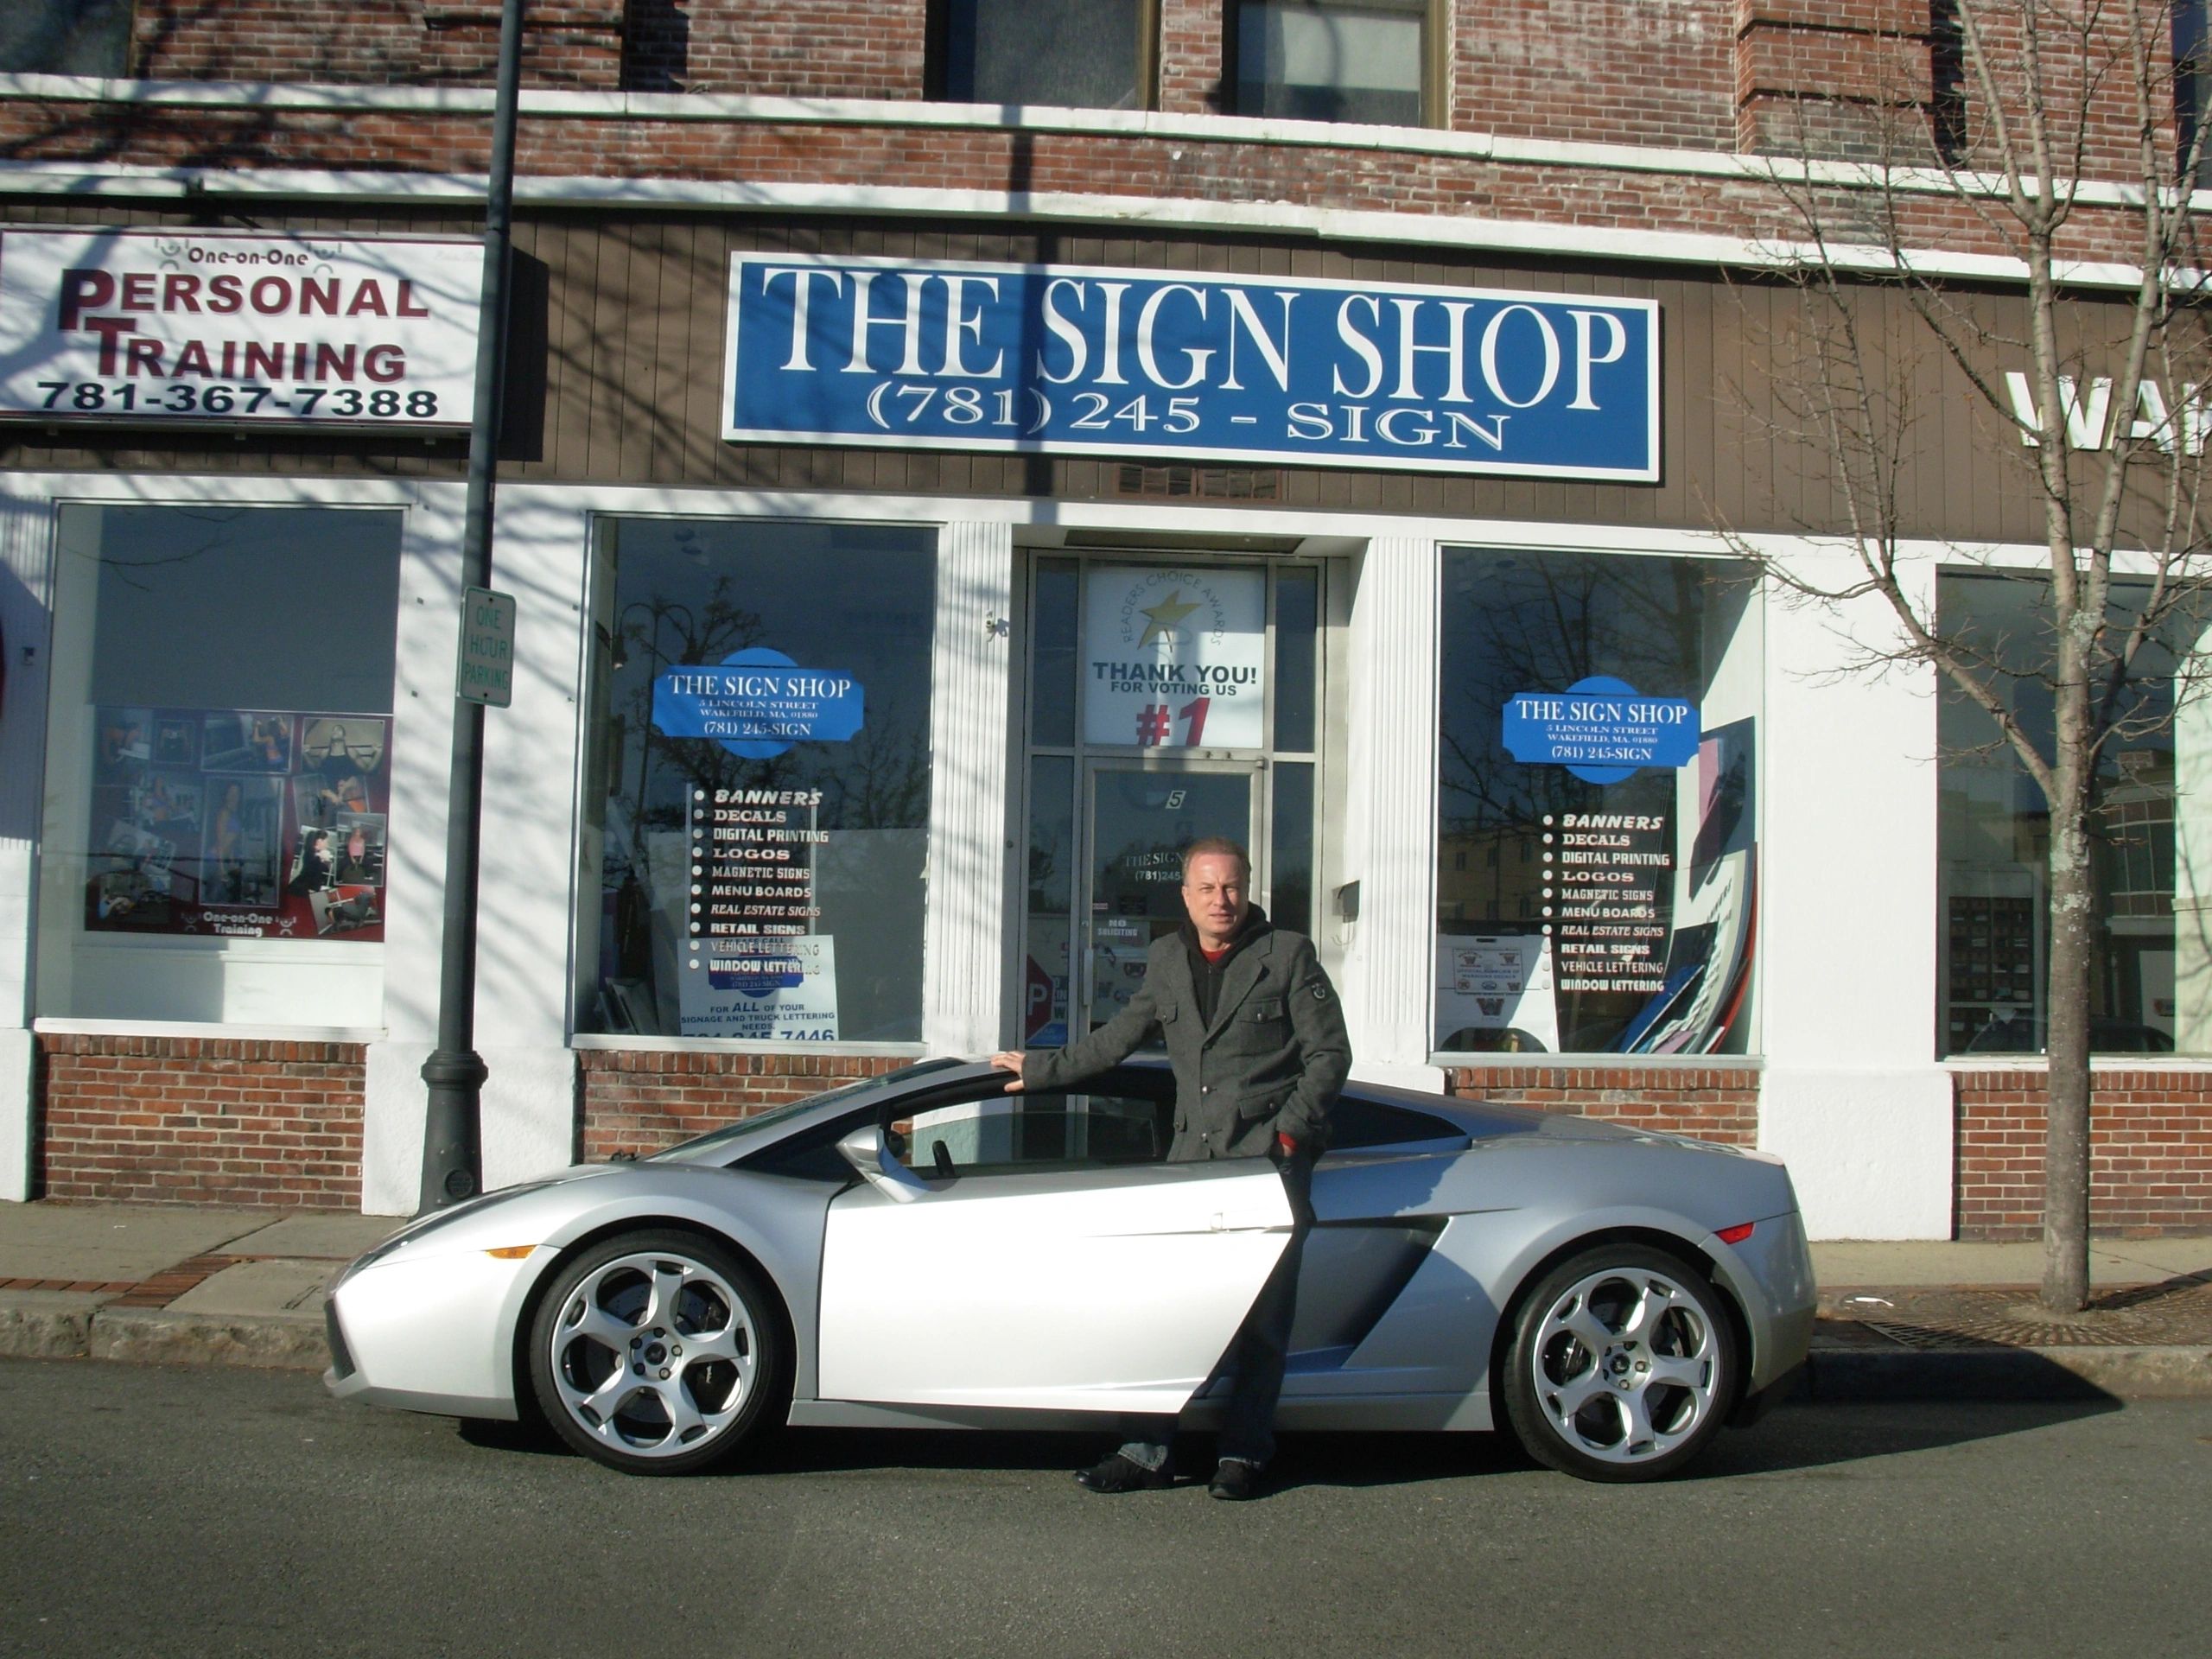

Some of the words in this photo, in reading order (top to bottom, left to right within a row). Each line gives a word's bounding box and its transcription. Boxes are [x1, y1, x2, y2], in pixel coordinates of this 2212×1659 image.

[188, 245, 308, 267] One-on-One
[58, 268, 429, 333] PERSONAL
[762, 267, 1003, 378] THE
[1037, 278, 1300, 392] SIGN
[1333, 294, 1626, 410] SHOP
[84, 316, 407, 384] TRAINING
[37, 380, 439, 418] 781-367-7388
[867, 381, 1051, 435] (781)
[1070, 391, 1199, 433] 245
[1287, 403, 1510, 451] SIGN
[1146, 570, 1203, 588] CHOICE
[476, 606, 502, 630] ONE
[470, 634, 507, 659] HOUR
[464, 663, 508, 690] PARKING
[1092, 662, 1185, 683] THANK
[1196, 665, 1257, 685] YOU!
[668, 675, 719, 696] THE
[724, 676, 780, 697] SIGN
[786, 677, 851, 698] SHOP
[1111, 681, 1142, 693] FOR
[1148, 682, 1210, 695] VOTING
[1216, 684, 1237, 696] US
[1516, 700, 1564, 721] THE
[1570, 702, 1622, 722] SIGN
[1628, 704, 1688, 725] SHOP
[704, 721, 738, 735] (781)
[742, 722, 811, 736] 245-SIGN
[1135, 697, 1211, 747] #1
[1612, 726, 1659, 735] STREET
[1552, 746, 1583, 760] (781)
[1587, 747, 1652, 760] 245-SIGN
[715, 790, 823, 805] BANNERS
[1169, 791, 1183, 808] 5
[714, 810, 787, 823] DECALS
[1562, 814, 1663, 830] BANNERS
[713, 828, 764, 842] DIGITAL
[767, 830, 829, 843] PRINTING
[1562, 834, 1630, 847] DECALS
[713, 848, 790, 860] LOGOS
[1561, 852, 1609, 864] DIGITAL
[1612, 853, 1670, 866] PRINTING
[712, 866, 773, 879] MAGNETIC
[777, 868, 810, 879] SIGNS
[1561, 871, 1635, 882] LOGOS
[711, 885, 752, 897] MENU
[755, 886, 812, 898] BOARDS
[1561, 888, 1618, 900] MAGNETIC
[1622, 890, 1653, 901] SIGNS
[710, 904, 742, 915] REAL
[744, 905, 785, 916] ESTATE
[787, 906, 821, 917] SIGNS
[1561, 907, 1599, 918] MENU
[1602, 908, 1656, 918] BOARDS
[203, 912, 272, 924] One-on-One
[214, 923, 263, 937] Training
[710, 923, 759, 934] RETAIL
[763, 924, 805, 935] SIGNS
[1560, 925, 1590, 936] REAL
[1592, 926, 1630, 937] ESTATE
[1632, 926, 1664, 937] SIGNS
[711, 942, 754, 954] VEHICLE
[1561, 944, 1607, 954] RETAIL
[1610, 944, 1649, 955] SIGNS
[709, 959, 761, 973] WINDOW
[1561, 962, 1603, 973] VEHICLE
[1605, 962, 1663, 974] LETTERING
[1560, 979, 1609, 991] WINDOW
[1611, 980, 1664, 992] LETTERING
[732, 1002, 760, 1013] ALL
